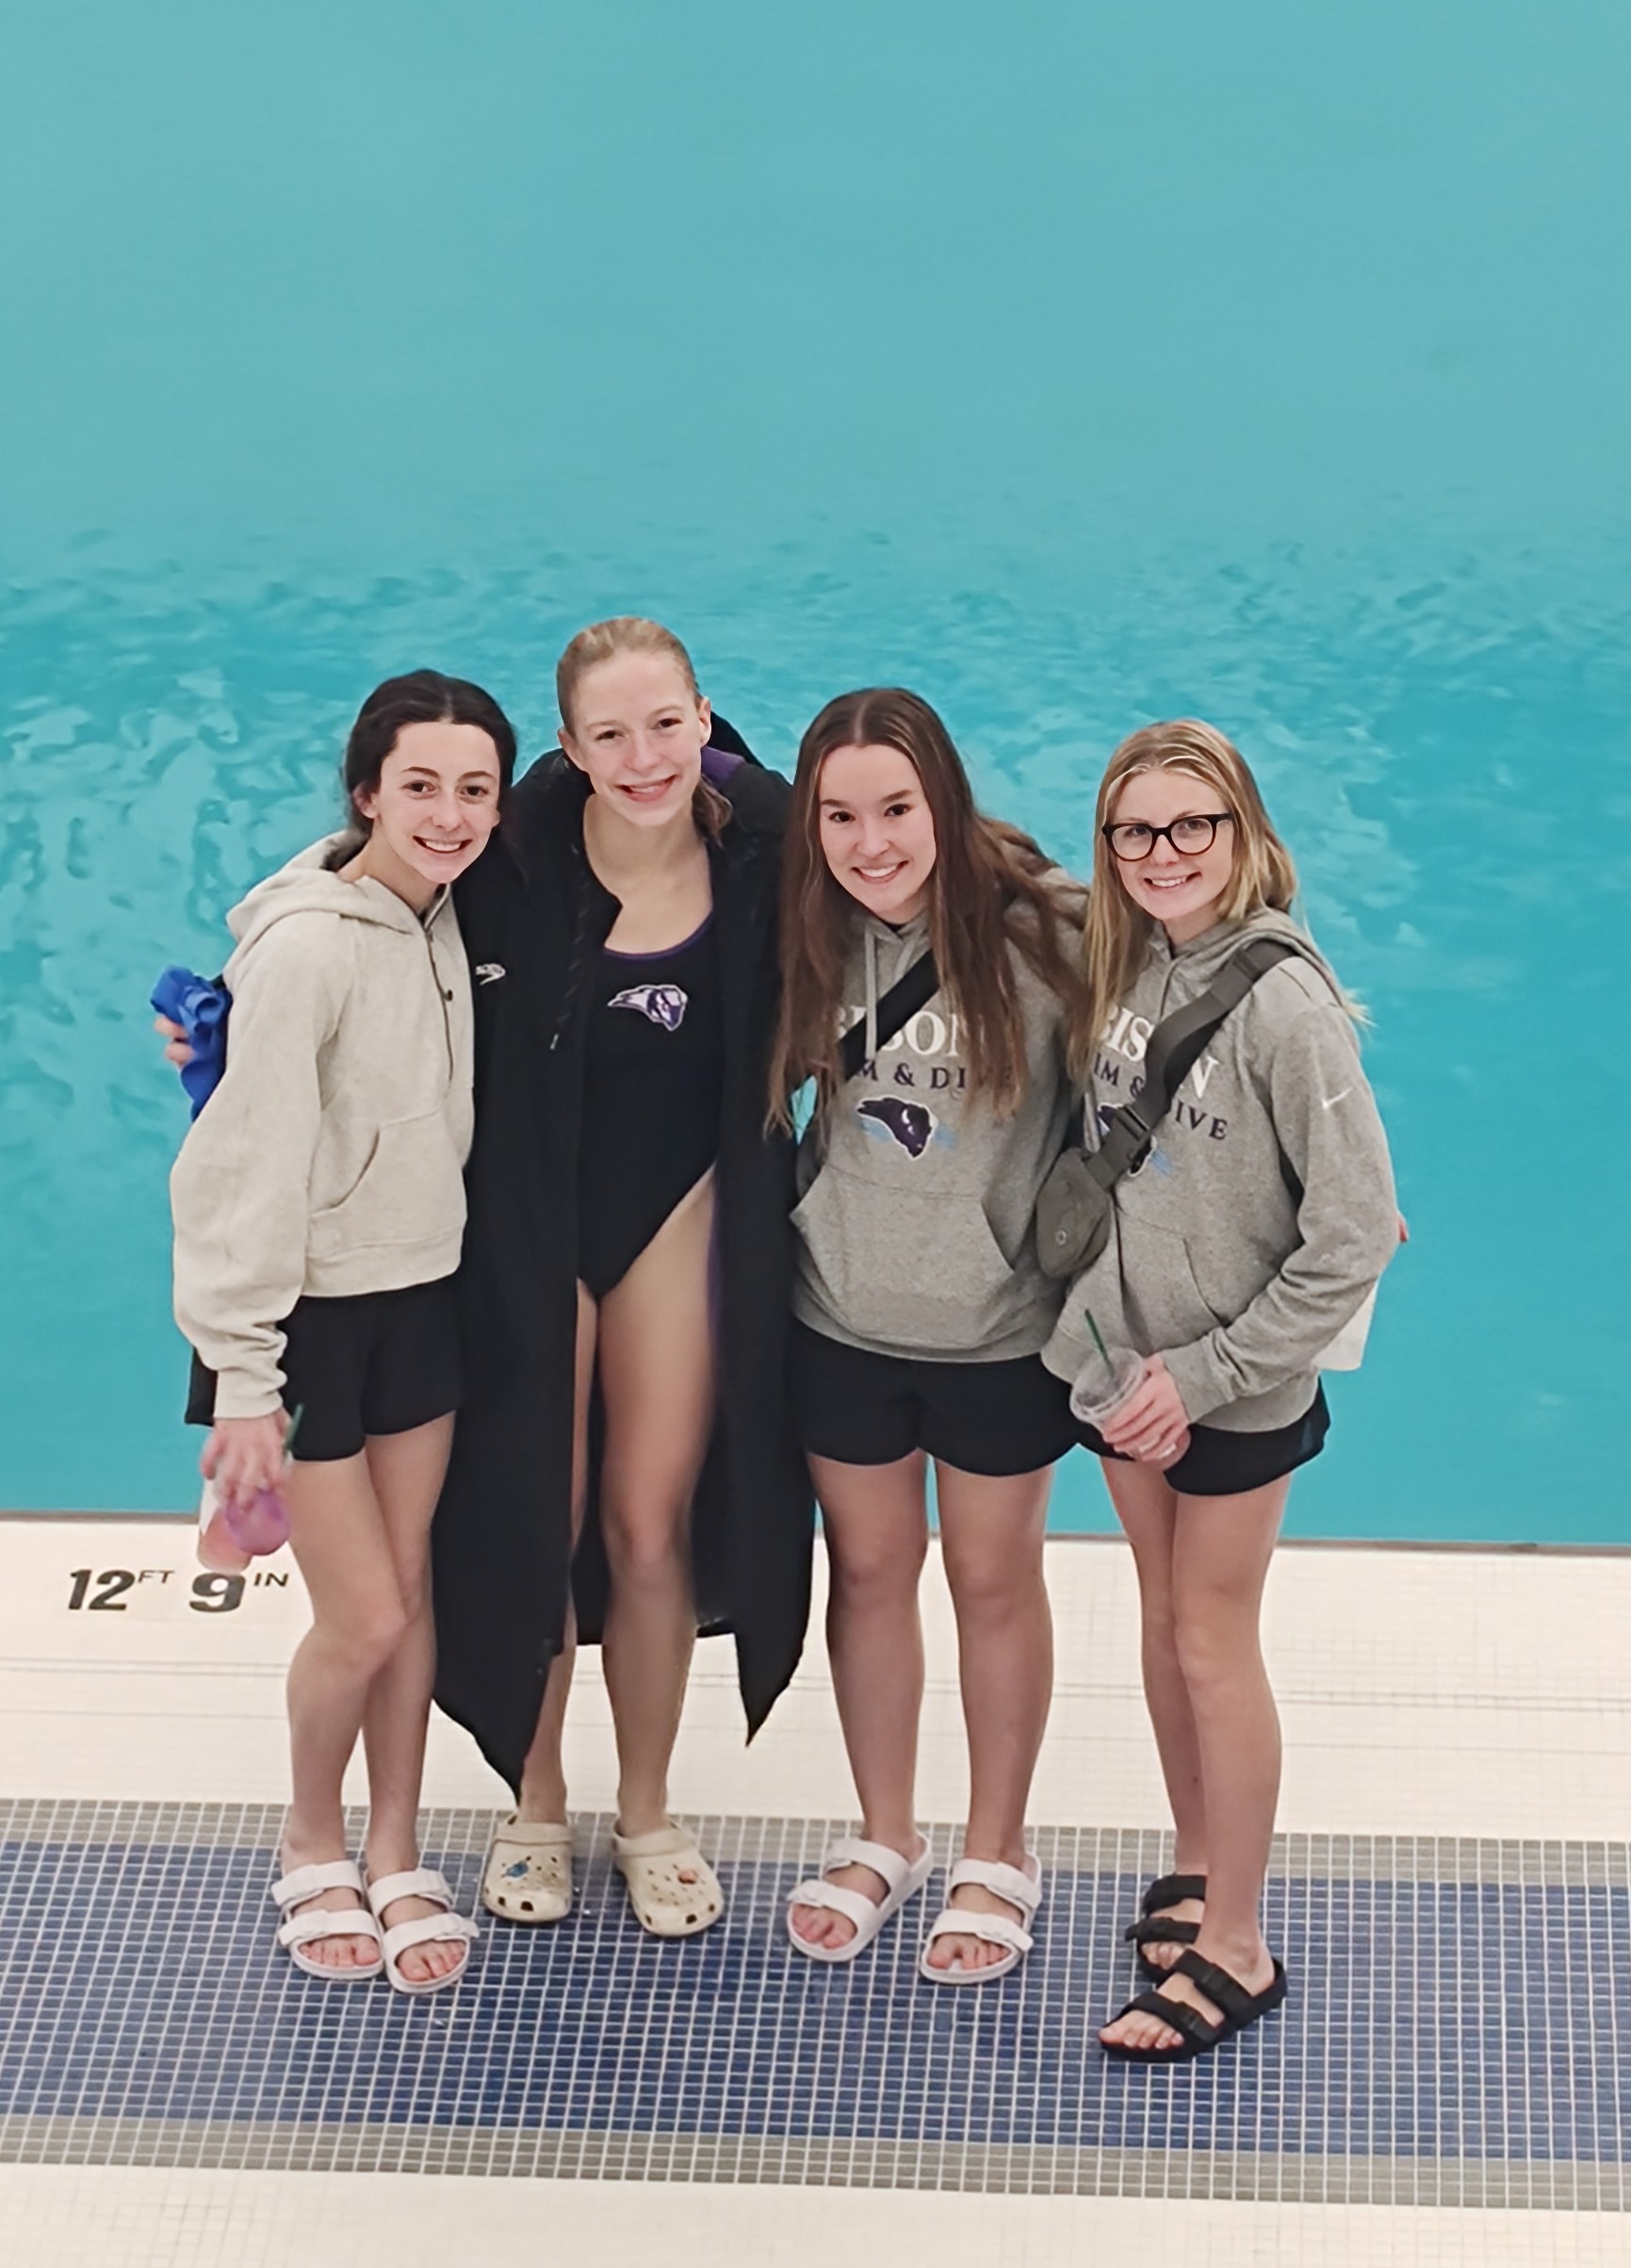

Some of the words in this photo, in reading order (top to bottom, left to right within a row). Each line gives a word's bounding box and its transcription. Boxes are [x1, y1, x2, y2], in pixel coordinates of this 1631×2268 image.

[893, 1062, 915, 1087] &
[930, 1067, 966, 1089] DI
[1093, 1052, 1120, 1087] IM
[1175, 1100, 1229, 1140] IVE
[68, 1569, 136, 1611] 12
[138, 1569, 174, 1584] FT
[188, 1572, 247, 1613] 9
[253, 1572, 289, 1587] IN
